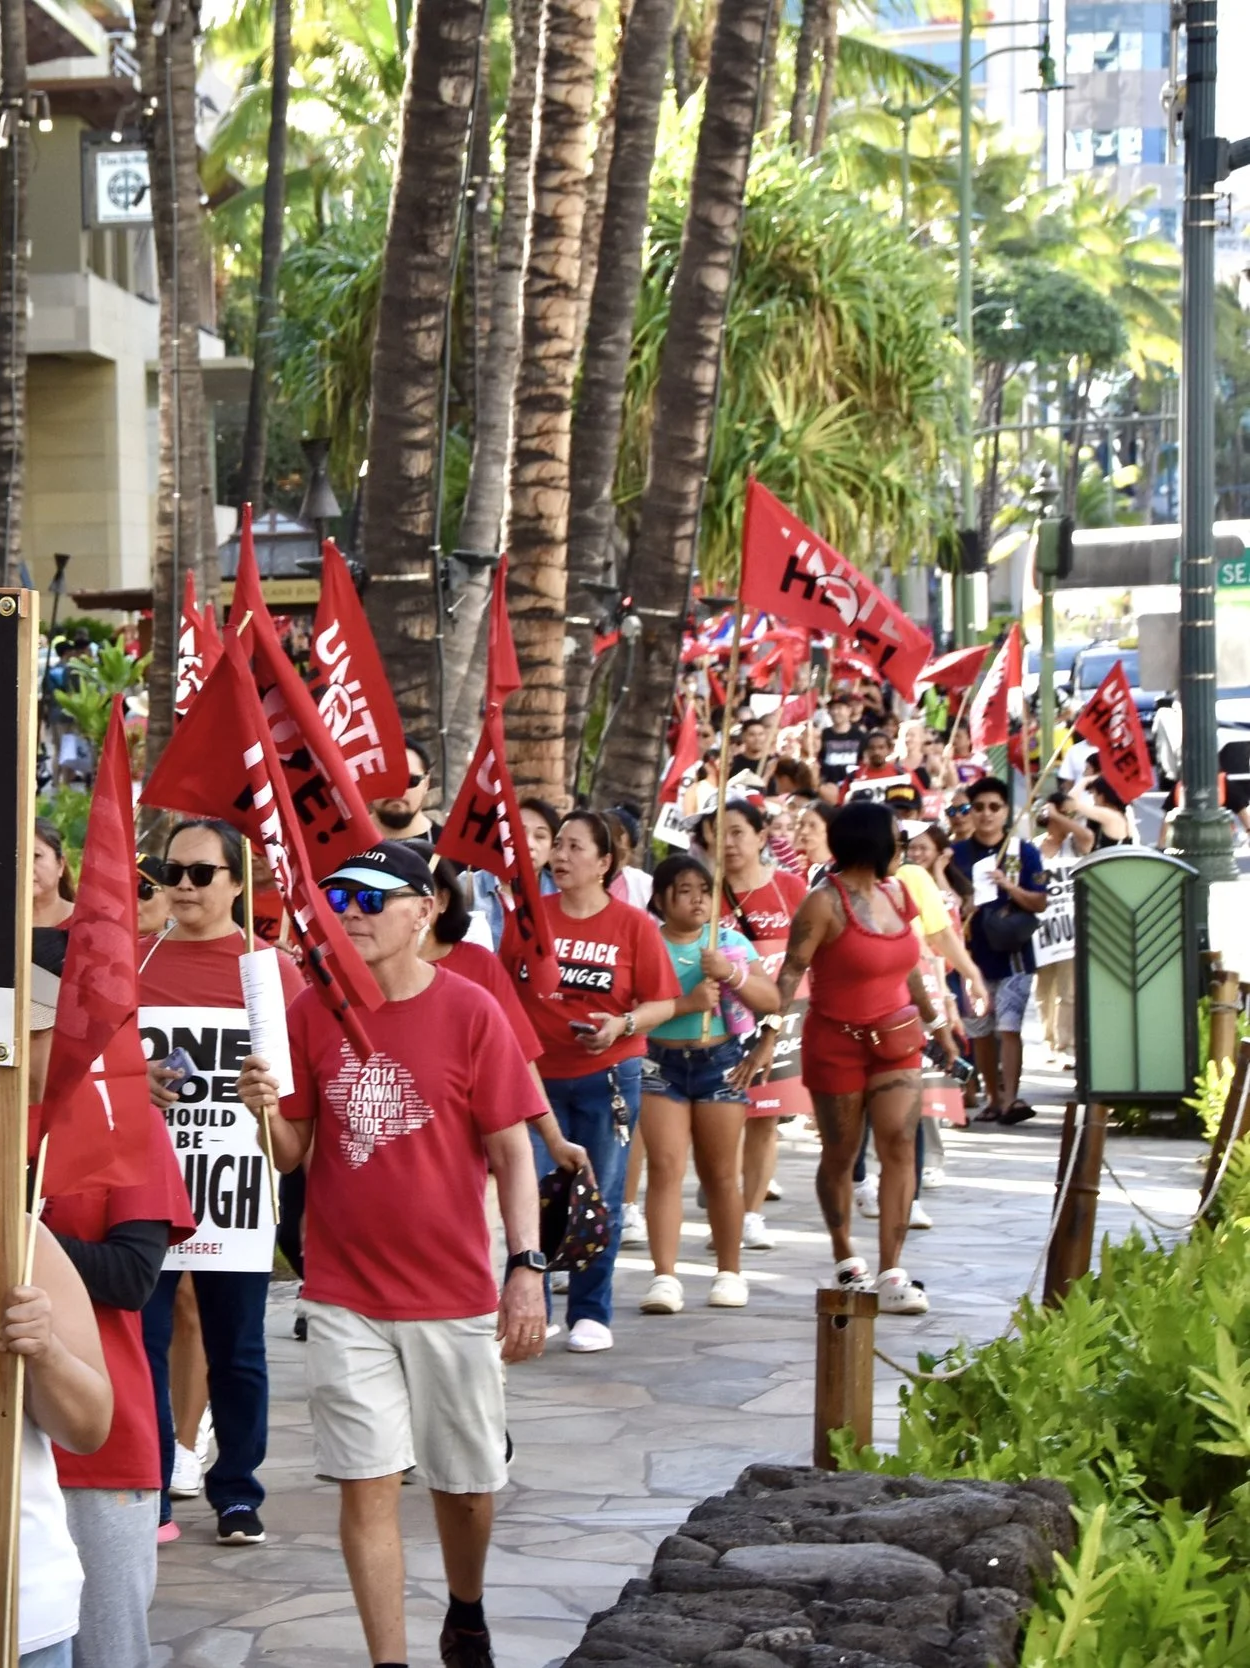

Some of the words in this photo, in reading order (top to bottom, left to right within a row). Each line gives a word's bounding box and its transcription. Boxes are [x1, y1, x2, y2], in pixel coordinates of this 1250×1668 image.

[1222, 563, 1250, 584] SE
[571, 940, 620, 966] BACK
[558, 965, 612, 990] ONGER
[359, 1067, 396, 1084] 2014
[351, 1084, 402, 1101] HAWAII
[164, 1108, 237, 1128] HOULD
[346, 1100, 406, 1119] CENTURY
[350, 1118, 385, 1135] RIDE
[176, 1131, 203, 1149] BE
[185, 1153, 263, 1230] UGH
